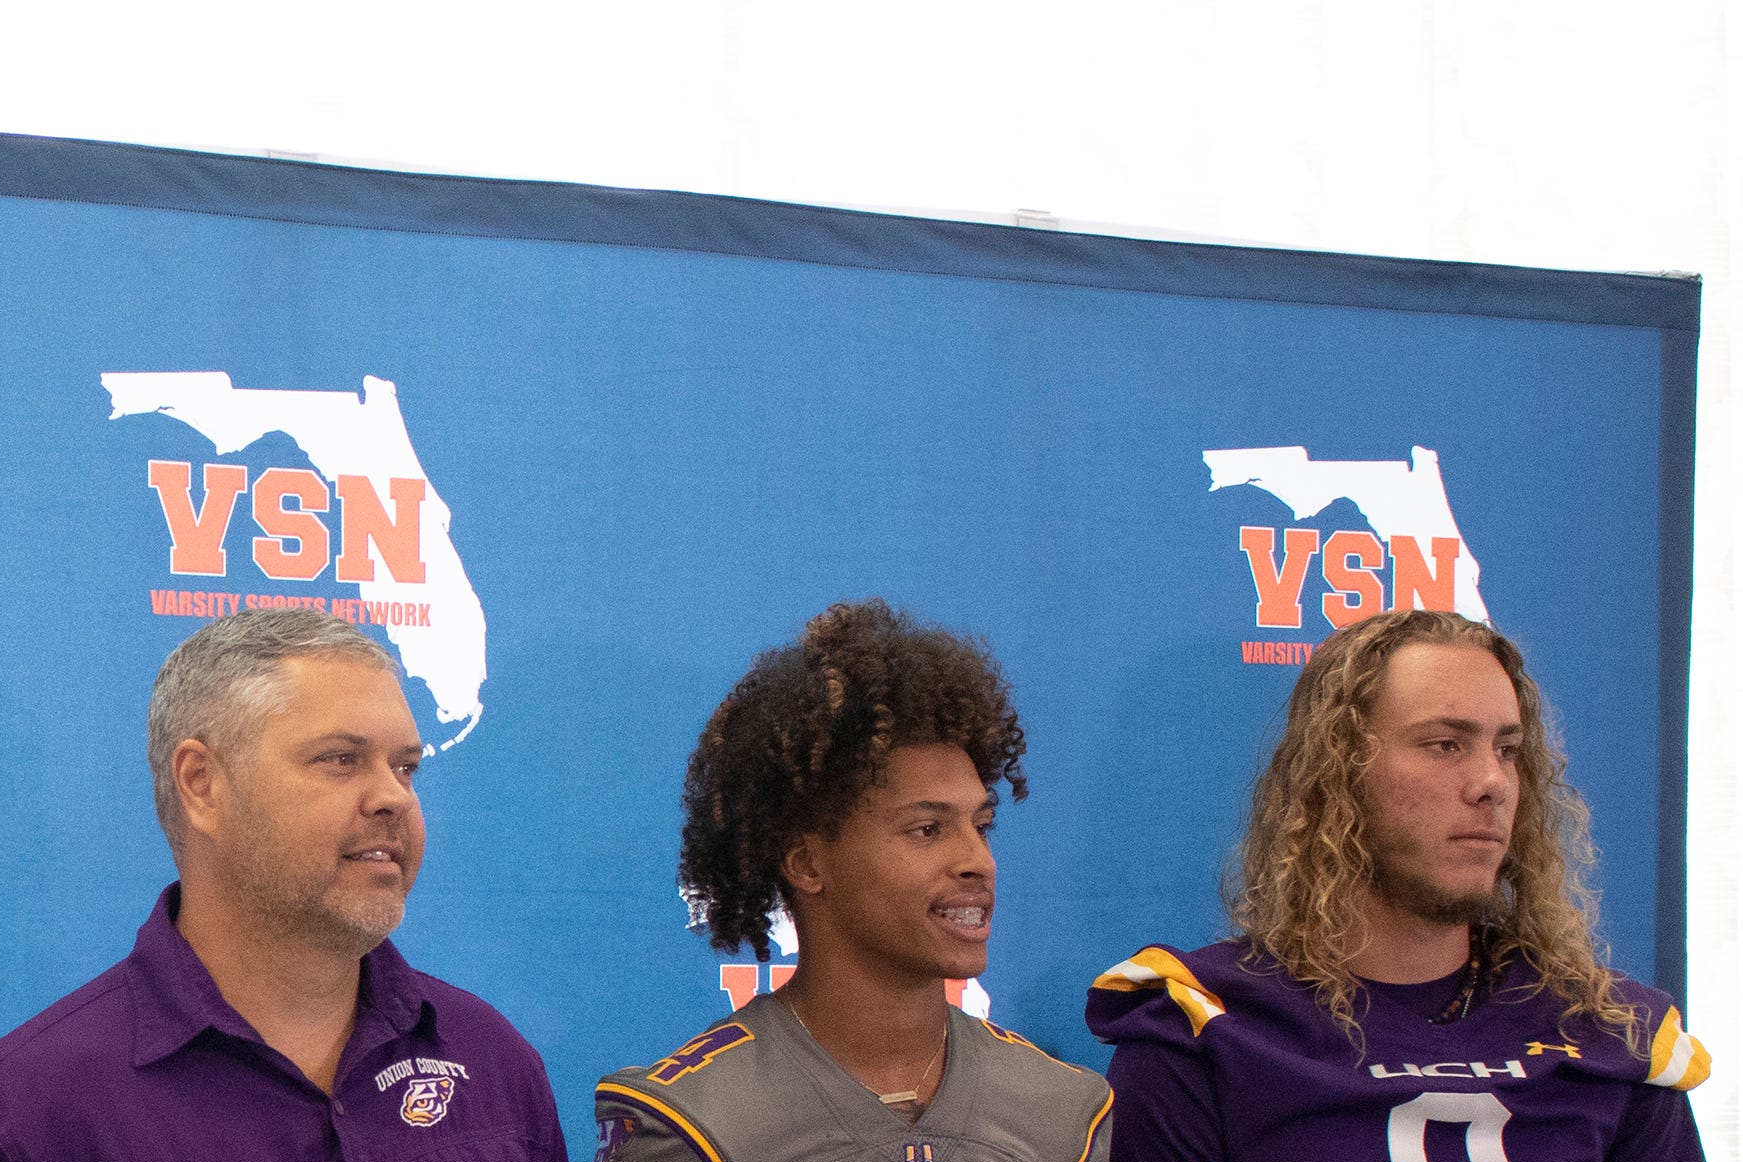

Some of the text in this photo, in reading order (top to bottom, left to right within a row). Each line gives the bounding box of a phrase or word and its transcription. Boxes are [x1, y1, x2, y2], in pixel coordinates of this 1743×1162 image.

[148, 460, 426, 584] VSN
[1239, 526, 1460, 629] VSN
[150, 590, 241, 618] VARSITY
[331, 598, 432, 627] NETWORK
[1241, 641, 1313, 665] VARSITY
[374, 1057, 470, 1092] UNION COUNTY
[1368, 1059, 1527, 1079] UCH
